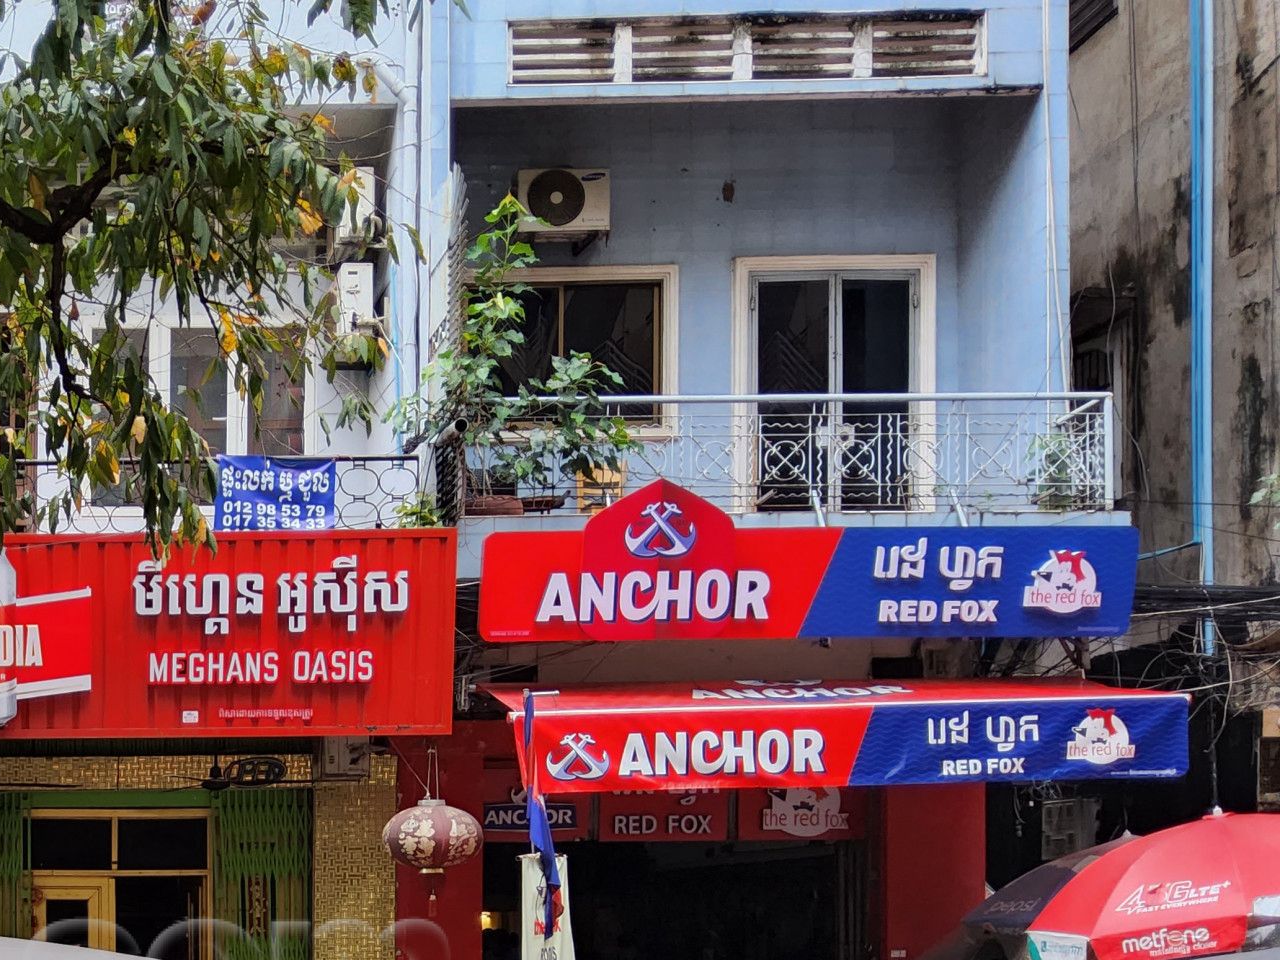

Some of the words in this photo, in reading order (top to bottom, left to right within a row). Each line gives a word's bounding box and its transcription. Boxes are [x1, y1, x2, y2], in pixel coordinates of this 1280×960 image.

[223, 501, 252, 514] 012
[257, 503, 276, 515] 98
[281, 504, 301, 517] 53
[306, 505, 326, 517] 79
[223, 514, 253, 527] 017
[257, 516, 276, 528] 35
[281, 517, 301, 528] 34
[306, 518, 325, 529] 33
[535, 569, 771, 623] ANCHOR
[1031, 589, 1052, 604] the
[1055, 588, 1077, 604] red
[1080, 588, 1099, 606] fox
[878, 599, 938, 624] RED
[942, 599, 999, 624] FOX
[149, 651, 280, 684] MEGHANS
[293, 650, 375, 683] OASIS
[618, 729, 825, 777] ANCHOR
[1069, 743, 1088, 757] the
[1091, 742, 1112, 757] red
[1116, 743, 1136, 758] fox
[942, 759, 982, 776] RED
[986, 757, 1024, 775] FOX
[484, 808, 574, 826] ANCOR
[614, 815, 658, 834] RED
[668, 815, 712, 834] FOX
[763, 810, 788, 827] the
[793, 810, 820, 827] red
[824, 811, 848, 828] fox
[1136, 904, 1161, 915] FAST
[1122, 926, 1210, 953] metfone
